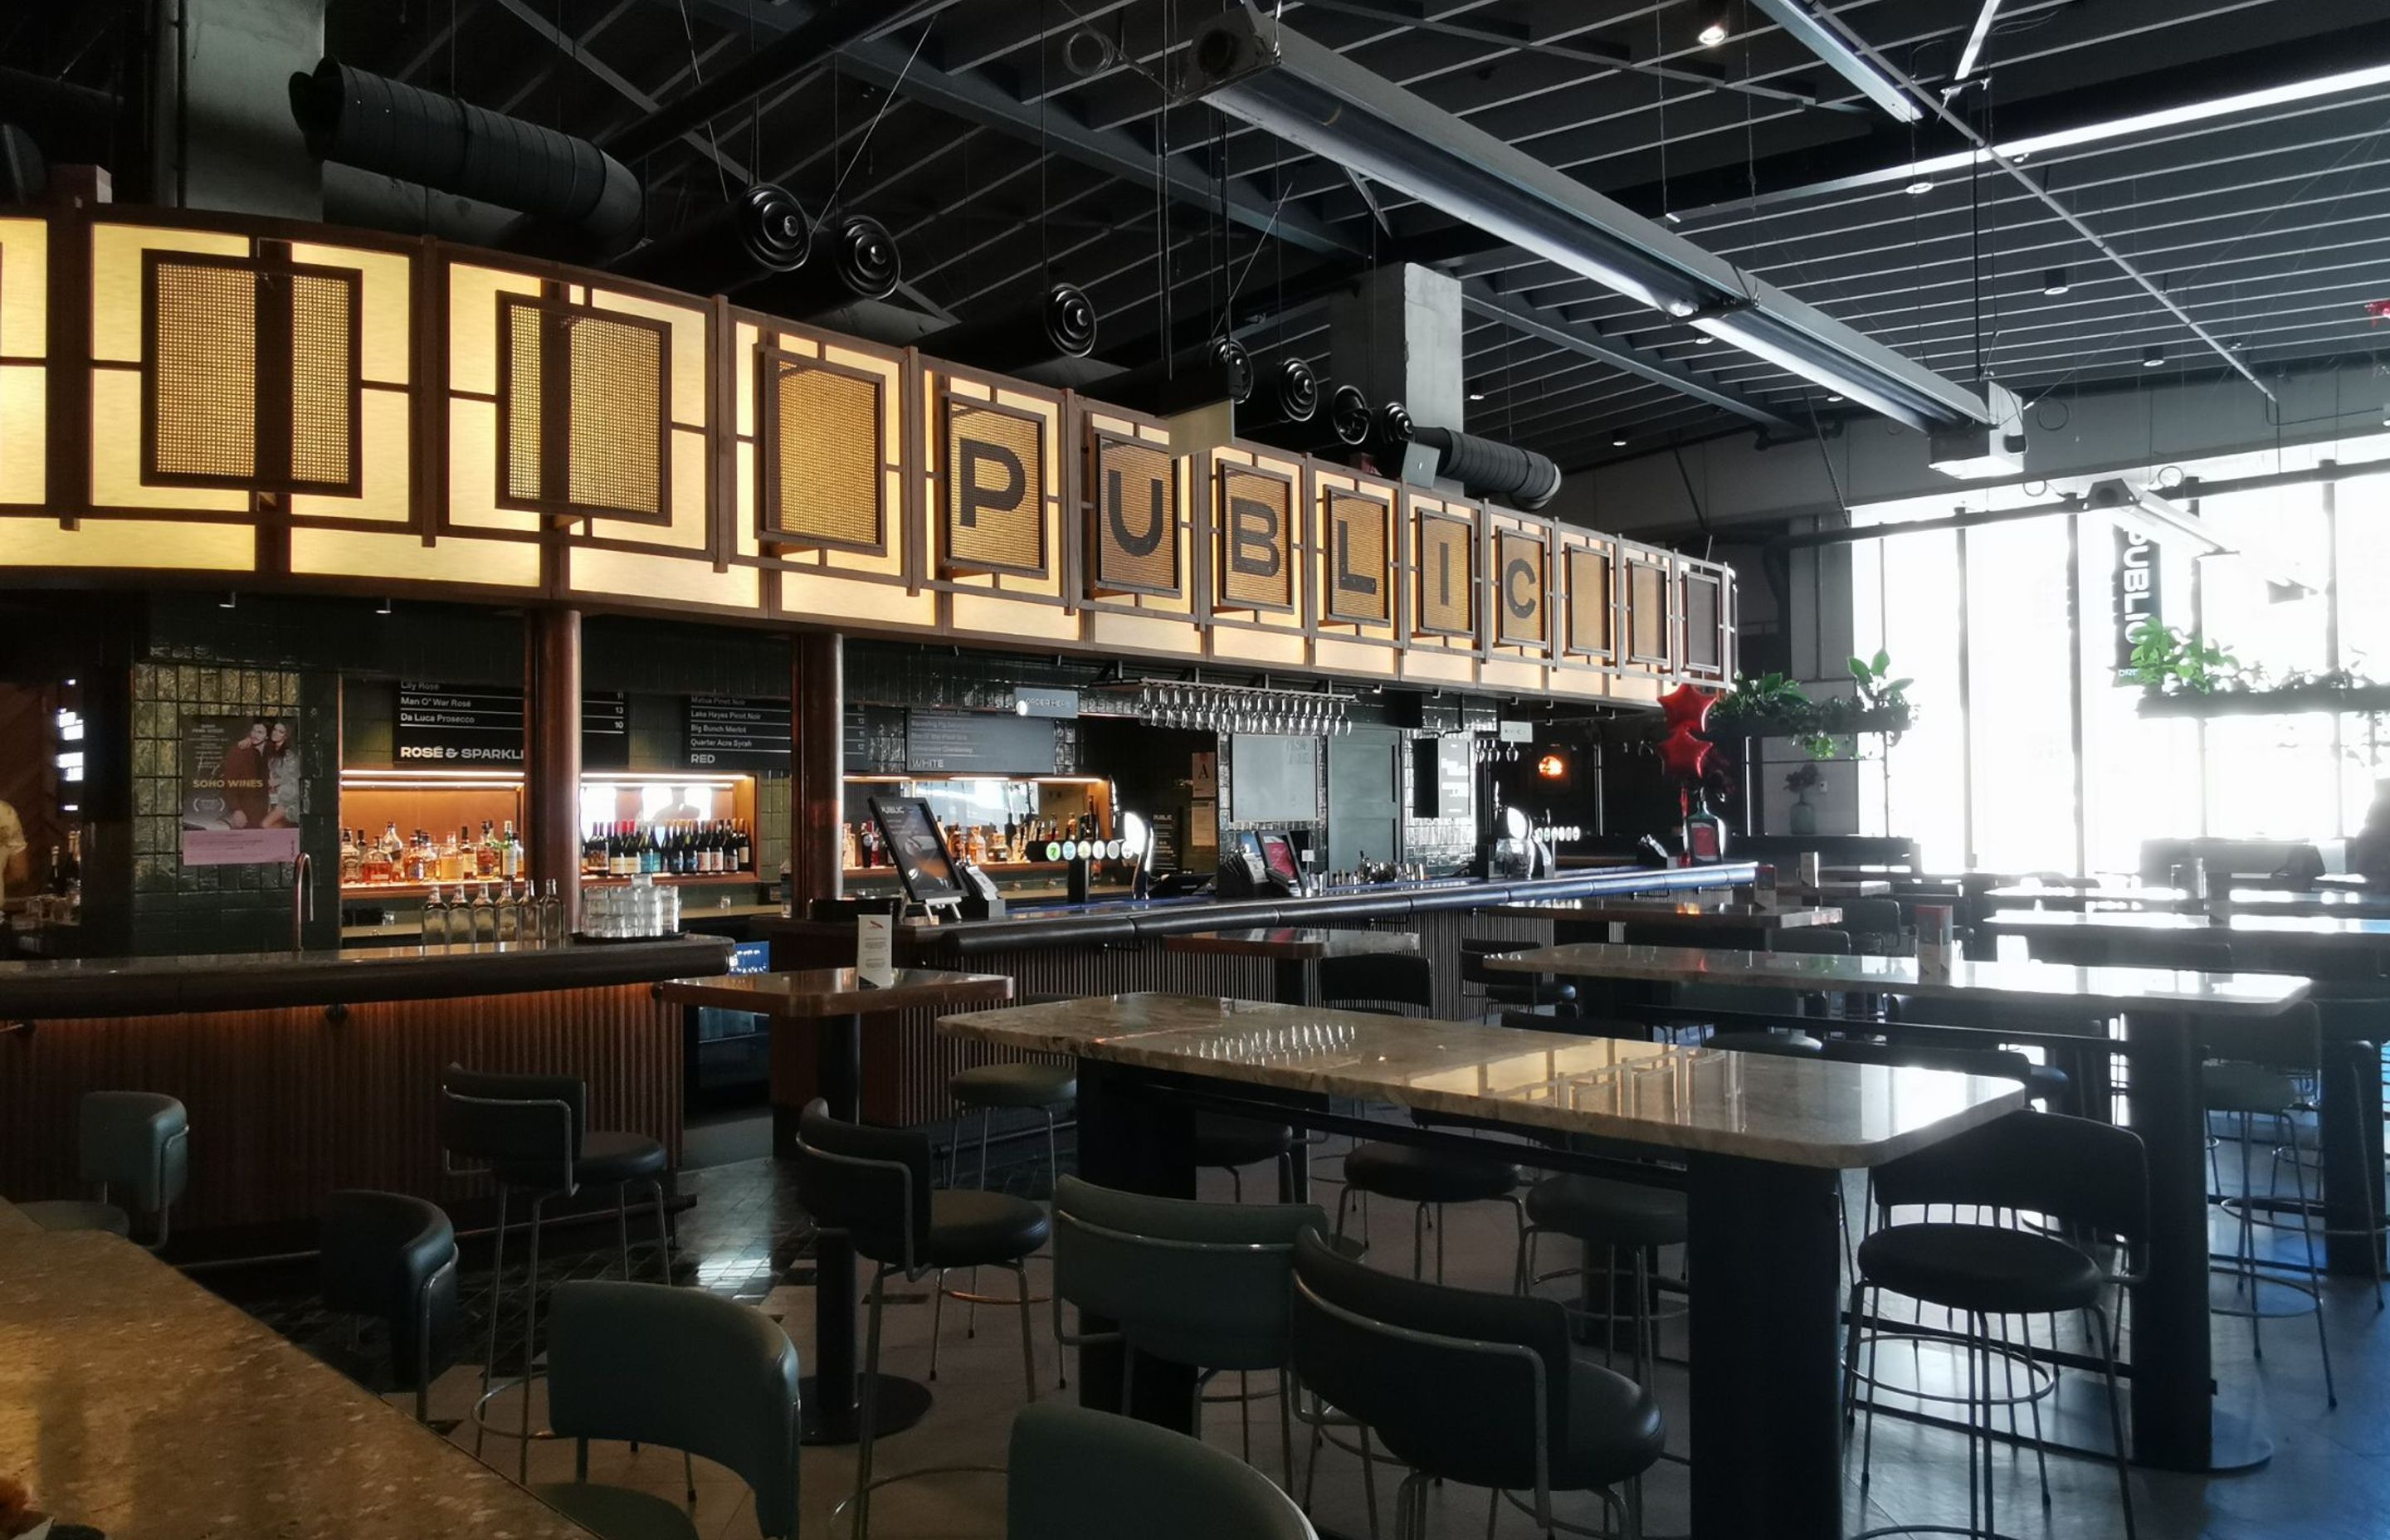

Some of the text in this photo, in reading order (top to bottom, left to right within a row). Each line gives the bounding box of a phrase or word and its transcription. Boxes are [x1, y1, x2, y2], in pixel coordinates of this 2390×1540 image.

[960, 436, 1537, 619] PUBLIC
[400, 696, 420, 705] Man
[432, 698, 450, 707] War
[400, 712, 476, 724] Da Luca Prosecco
[690, 709, 708, 719] Lake
[729, 711, 747, 719] Pinot
[748, 712, 762, 720] Noir
[614, 721, 623, 729] 10
[690, 724, 747, 733] Big Bunch Merlot
[690, 738, 753, 749] Quarter Acre Syrah
[400, 744, 524, 760] ROSÉ & SPARKLI
[690, 754, 715, 764] RED
[911, 758, 944, 768] WHITE
[1198, 763, 1209, 779] A
[193, 778, 264, 789] SOHO WINES
